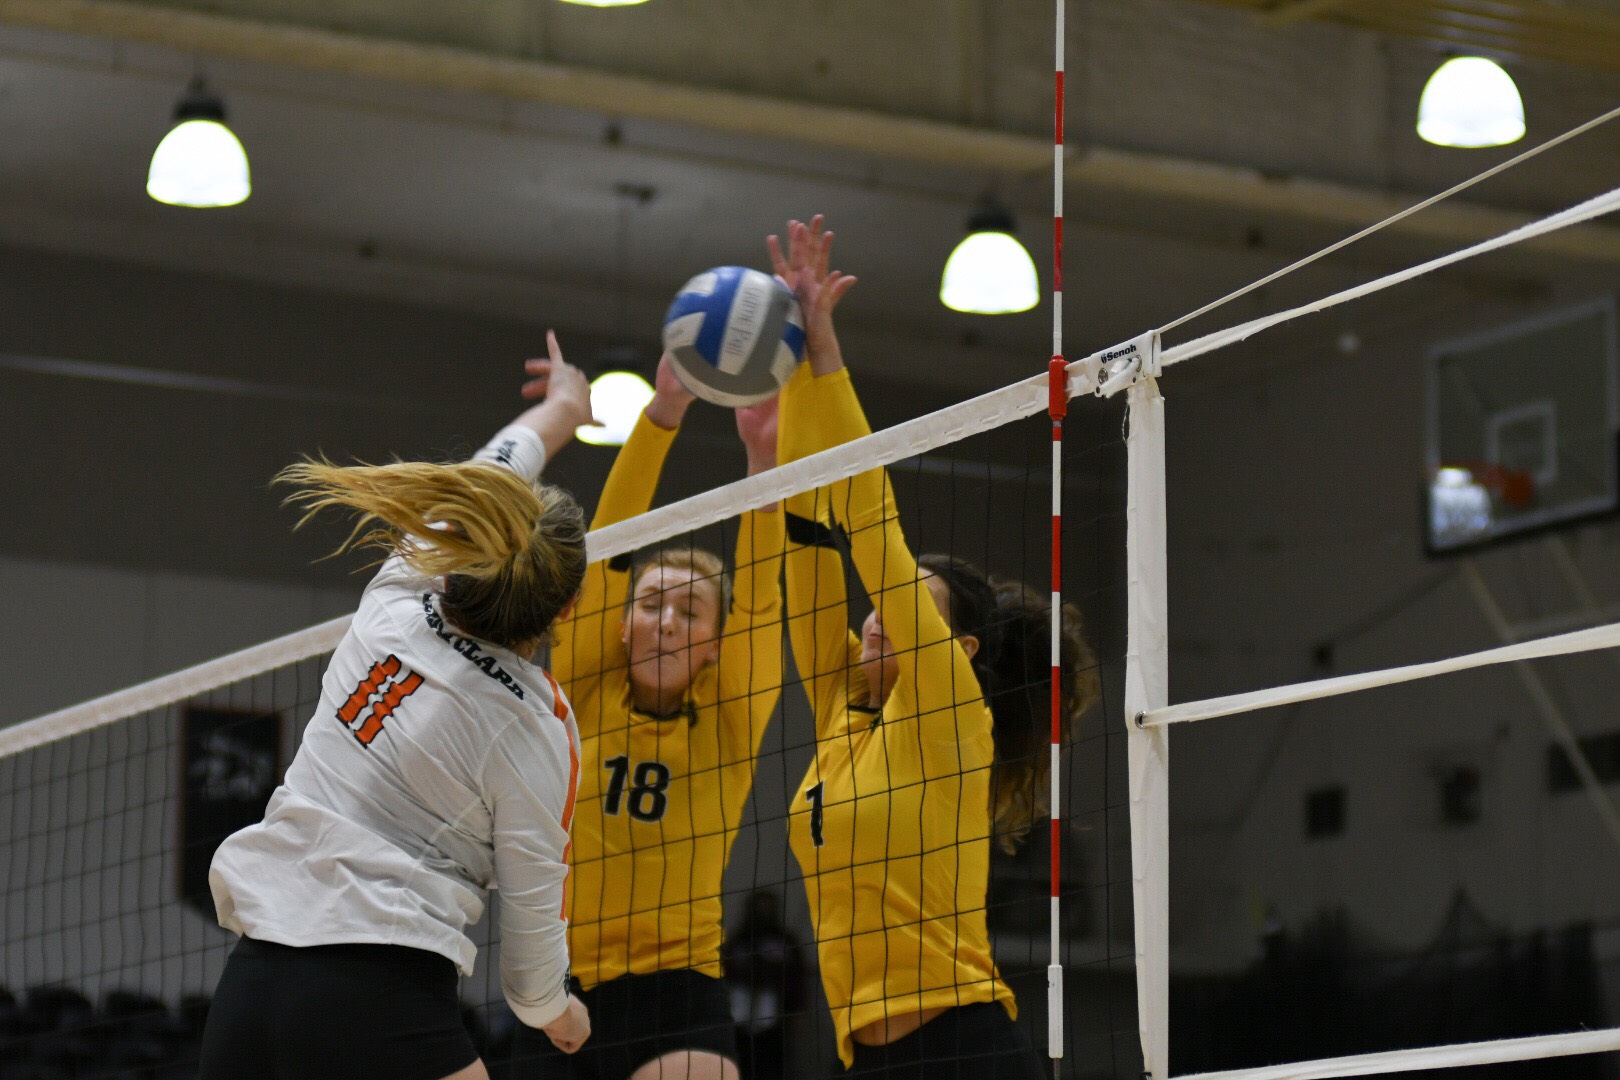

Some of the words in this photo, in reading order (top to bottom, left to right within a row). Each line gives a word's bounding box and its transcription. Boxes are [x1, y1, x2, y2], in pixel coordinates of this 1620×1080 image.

[1104, 344, 1137, 362] Senoh
[335, 653, 425, 749] 11
[603, 753, 672, 824] 18
[805, 779, 825, 848] 1
